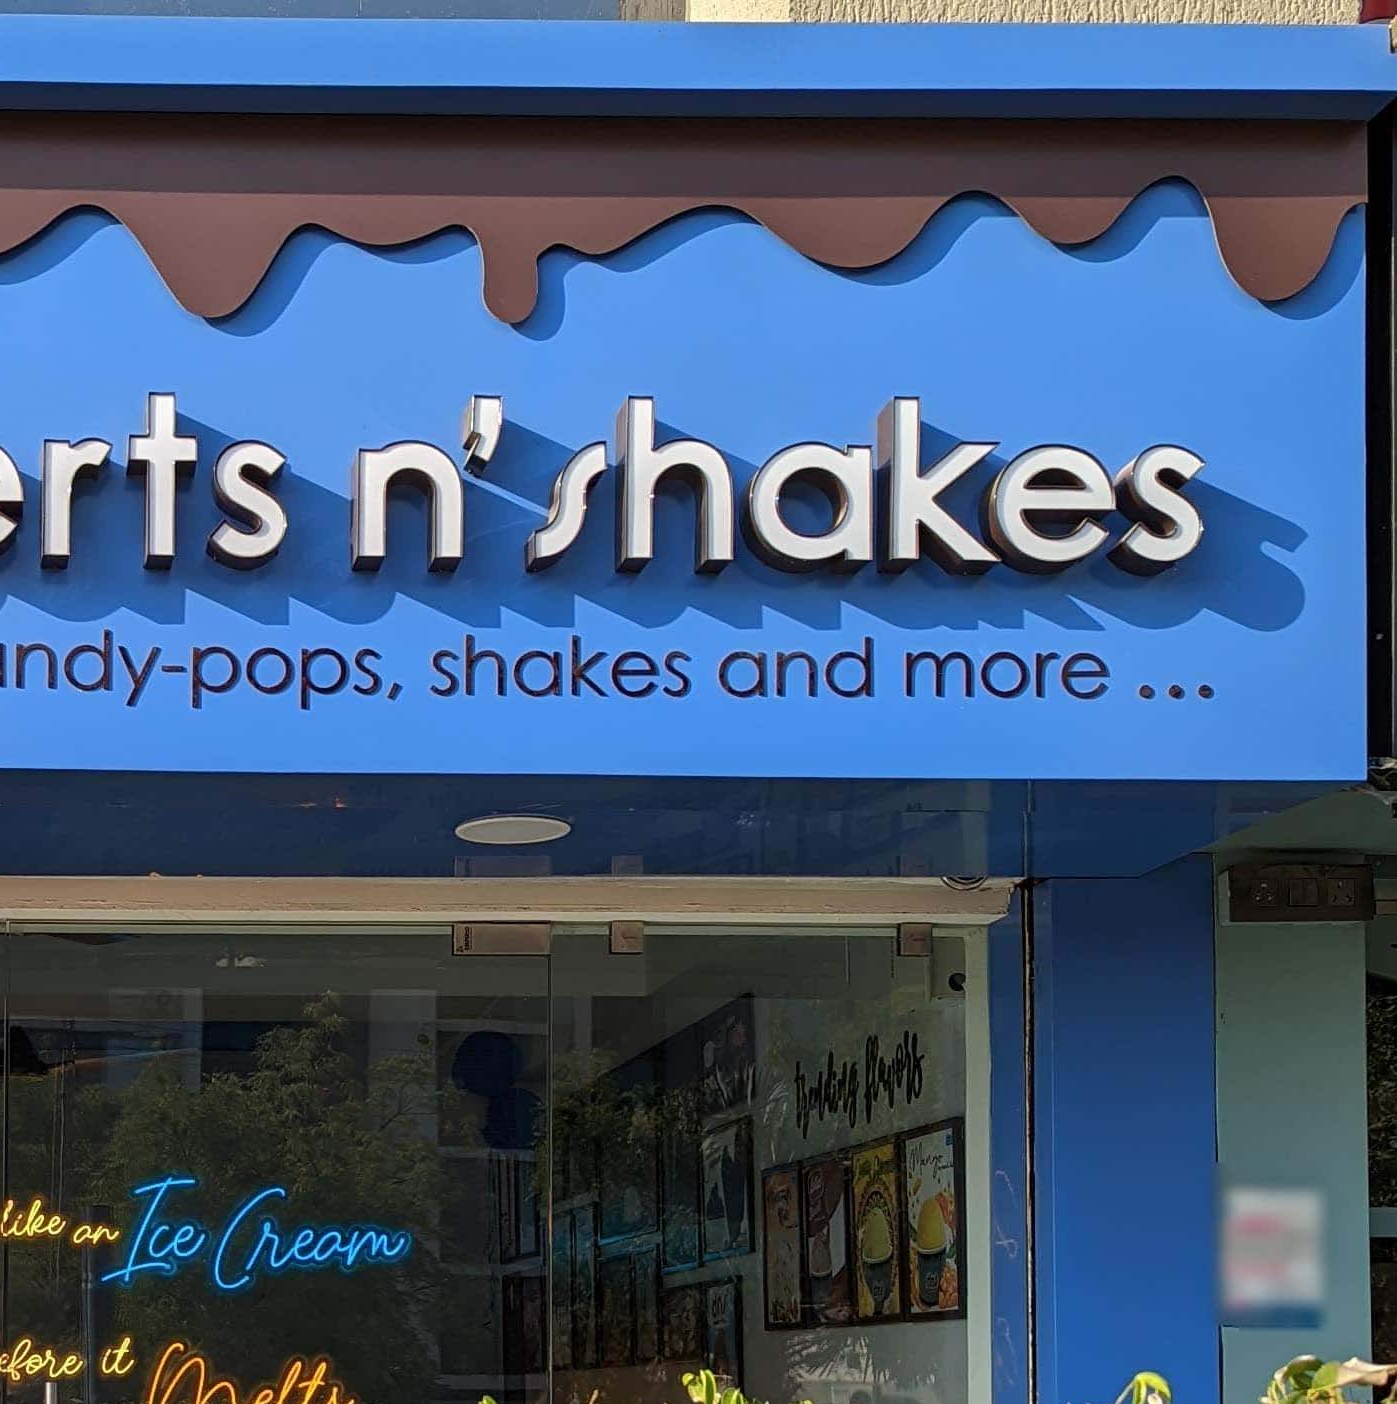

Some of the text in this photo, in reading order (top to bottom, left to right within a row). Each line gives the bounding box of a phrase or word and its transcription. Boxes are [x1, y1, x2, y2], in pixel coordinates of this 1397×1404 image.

[525, 395, 1206, 575] shakes
[430, 635, 691, 699] shakes
[718, 637, 875, 699] and
[906, 648, 1111, 699] more
[1, 1199, 68, 1236] like
[72, 1220, 121, 1245] an
[101, 1176, 207, 1283] Ice
[213, 1187, 407, 1289] Cream
[101, 1337, 135, 1375] it
